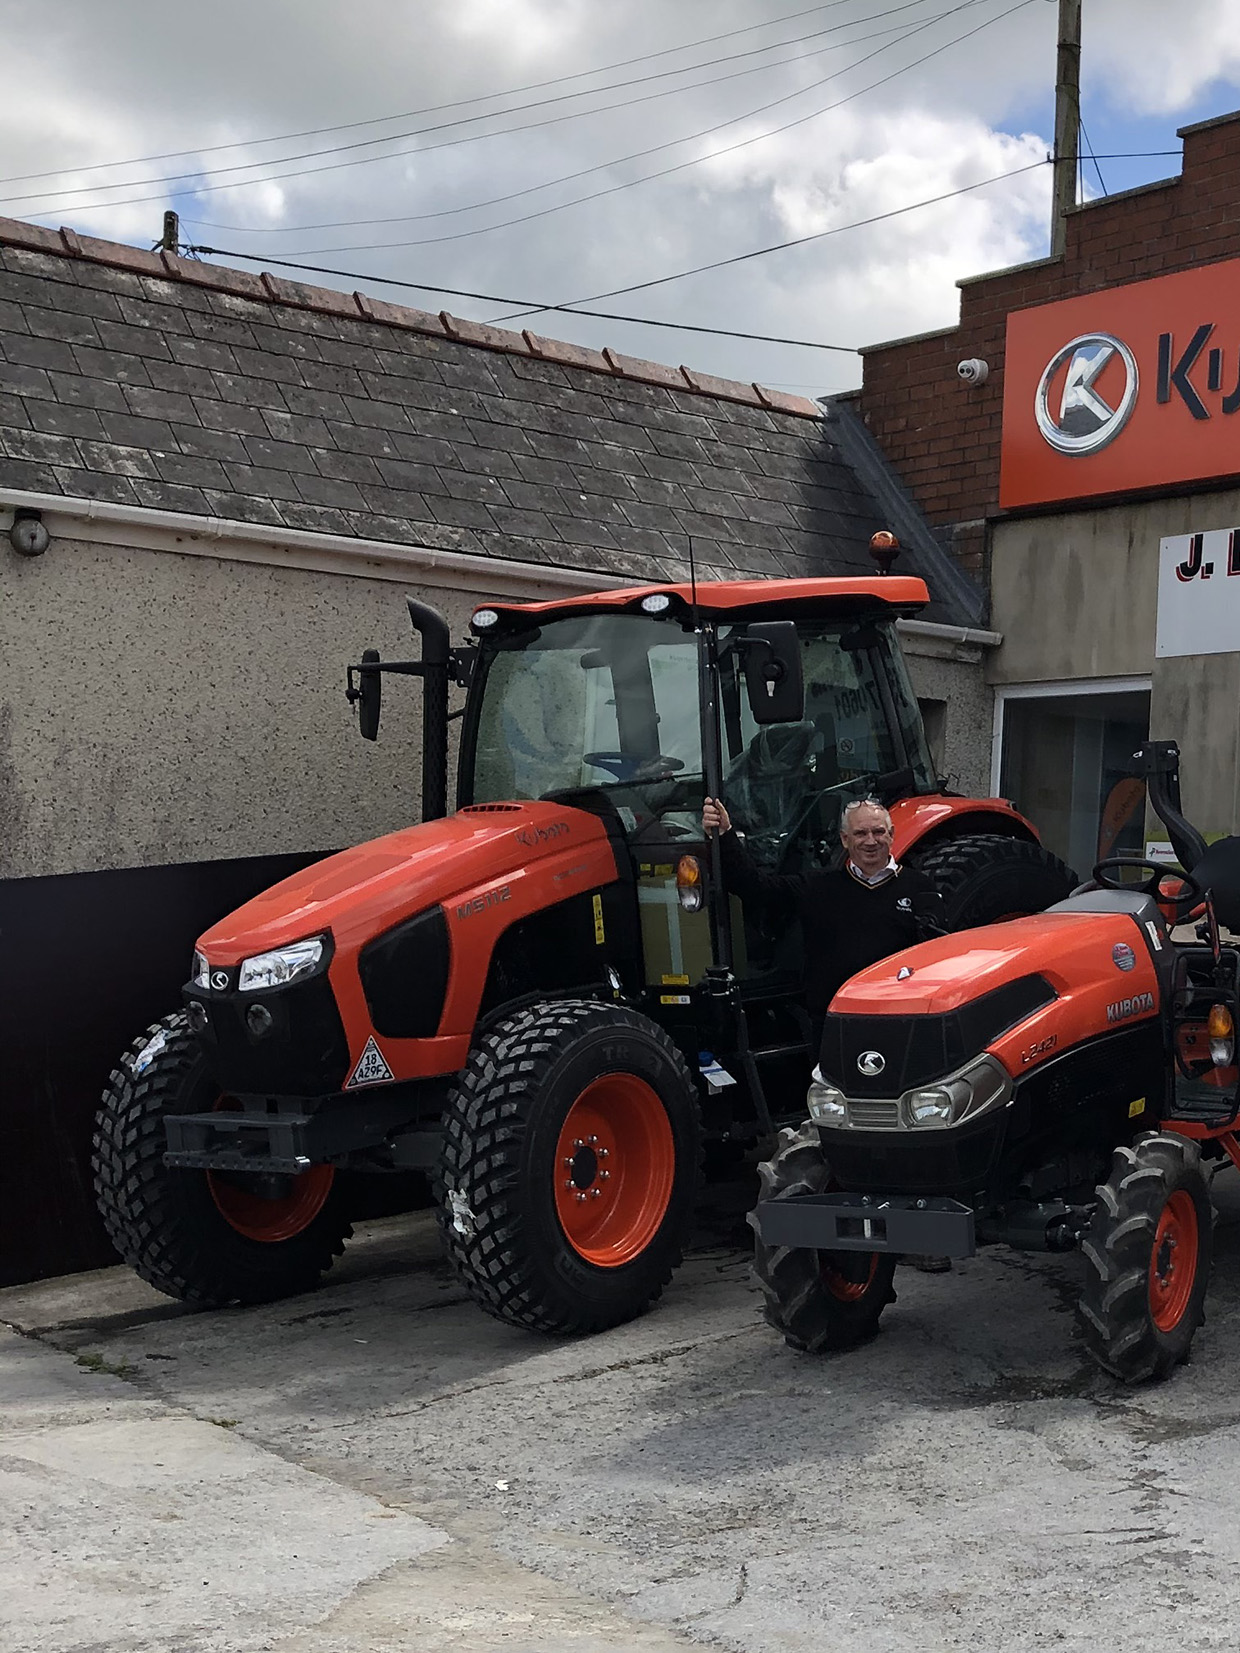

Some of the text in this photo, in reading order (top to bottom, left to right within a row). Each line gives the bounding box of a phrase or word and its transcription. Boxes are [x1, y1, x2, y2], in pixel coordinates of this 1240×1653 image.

[1176, 533, 1214, 582] J.
[1106, 992, 1155, 1024] KUBOTA
[365, 1053, 377, 1066] 18
